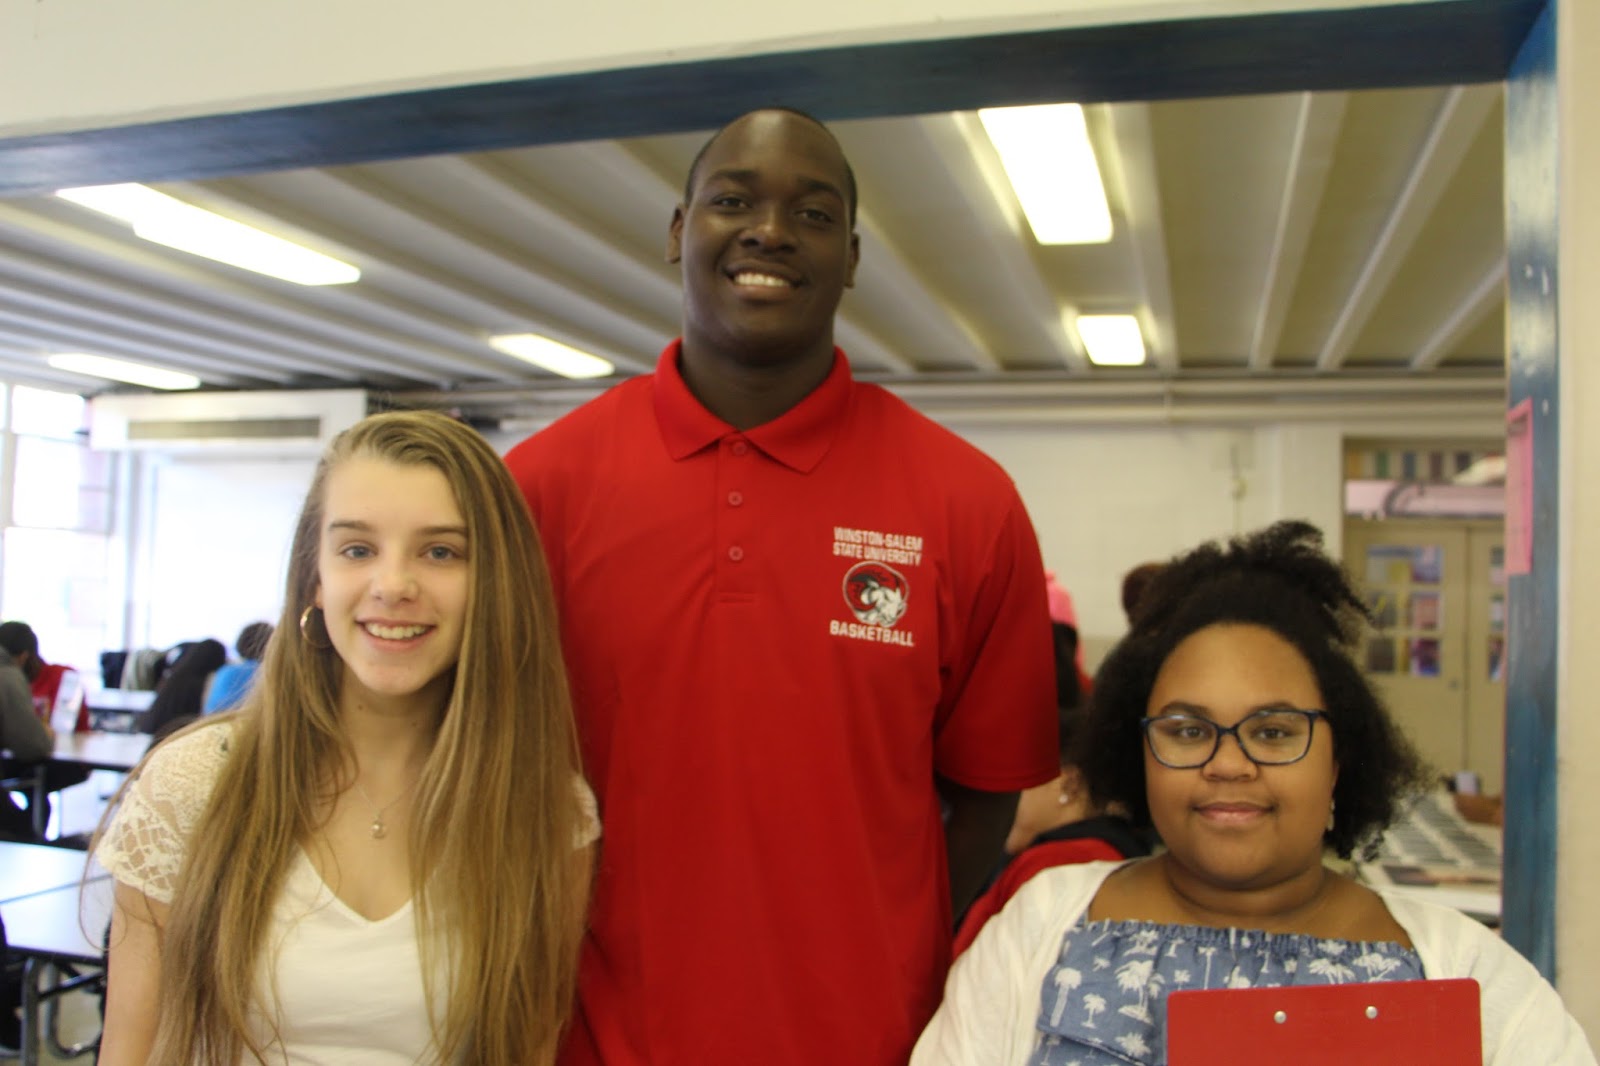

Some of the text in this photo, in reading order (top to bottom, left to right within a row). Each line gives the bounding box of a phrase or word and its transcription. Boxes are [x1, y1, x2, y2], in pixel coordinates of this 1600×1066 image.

[833, 526, 923, 551] WINSTON-SALEM
[832, 541, 922, 567] STATE UNIVERSITY
[829, 619, 915, 647] BASKETBALL
